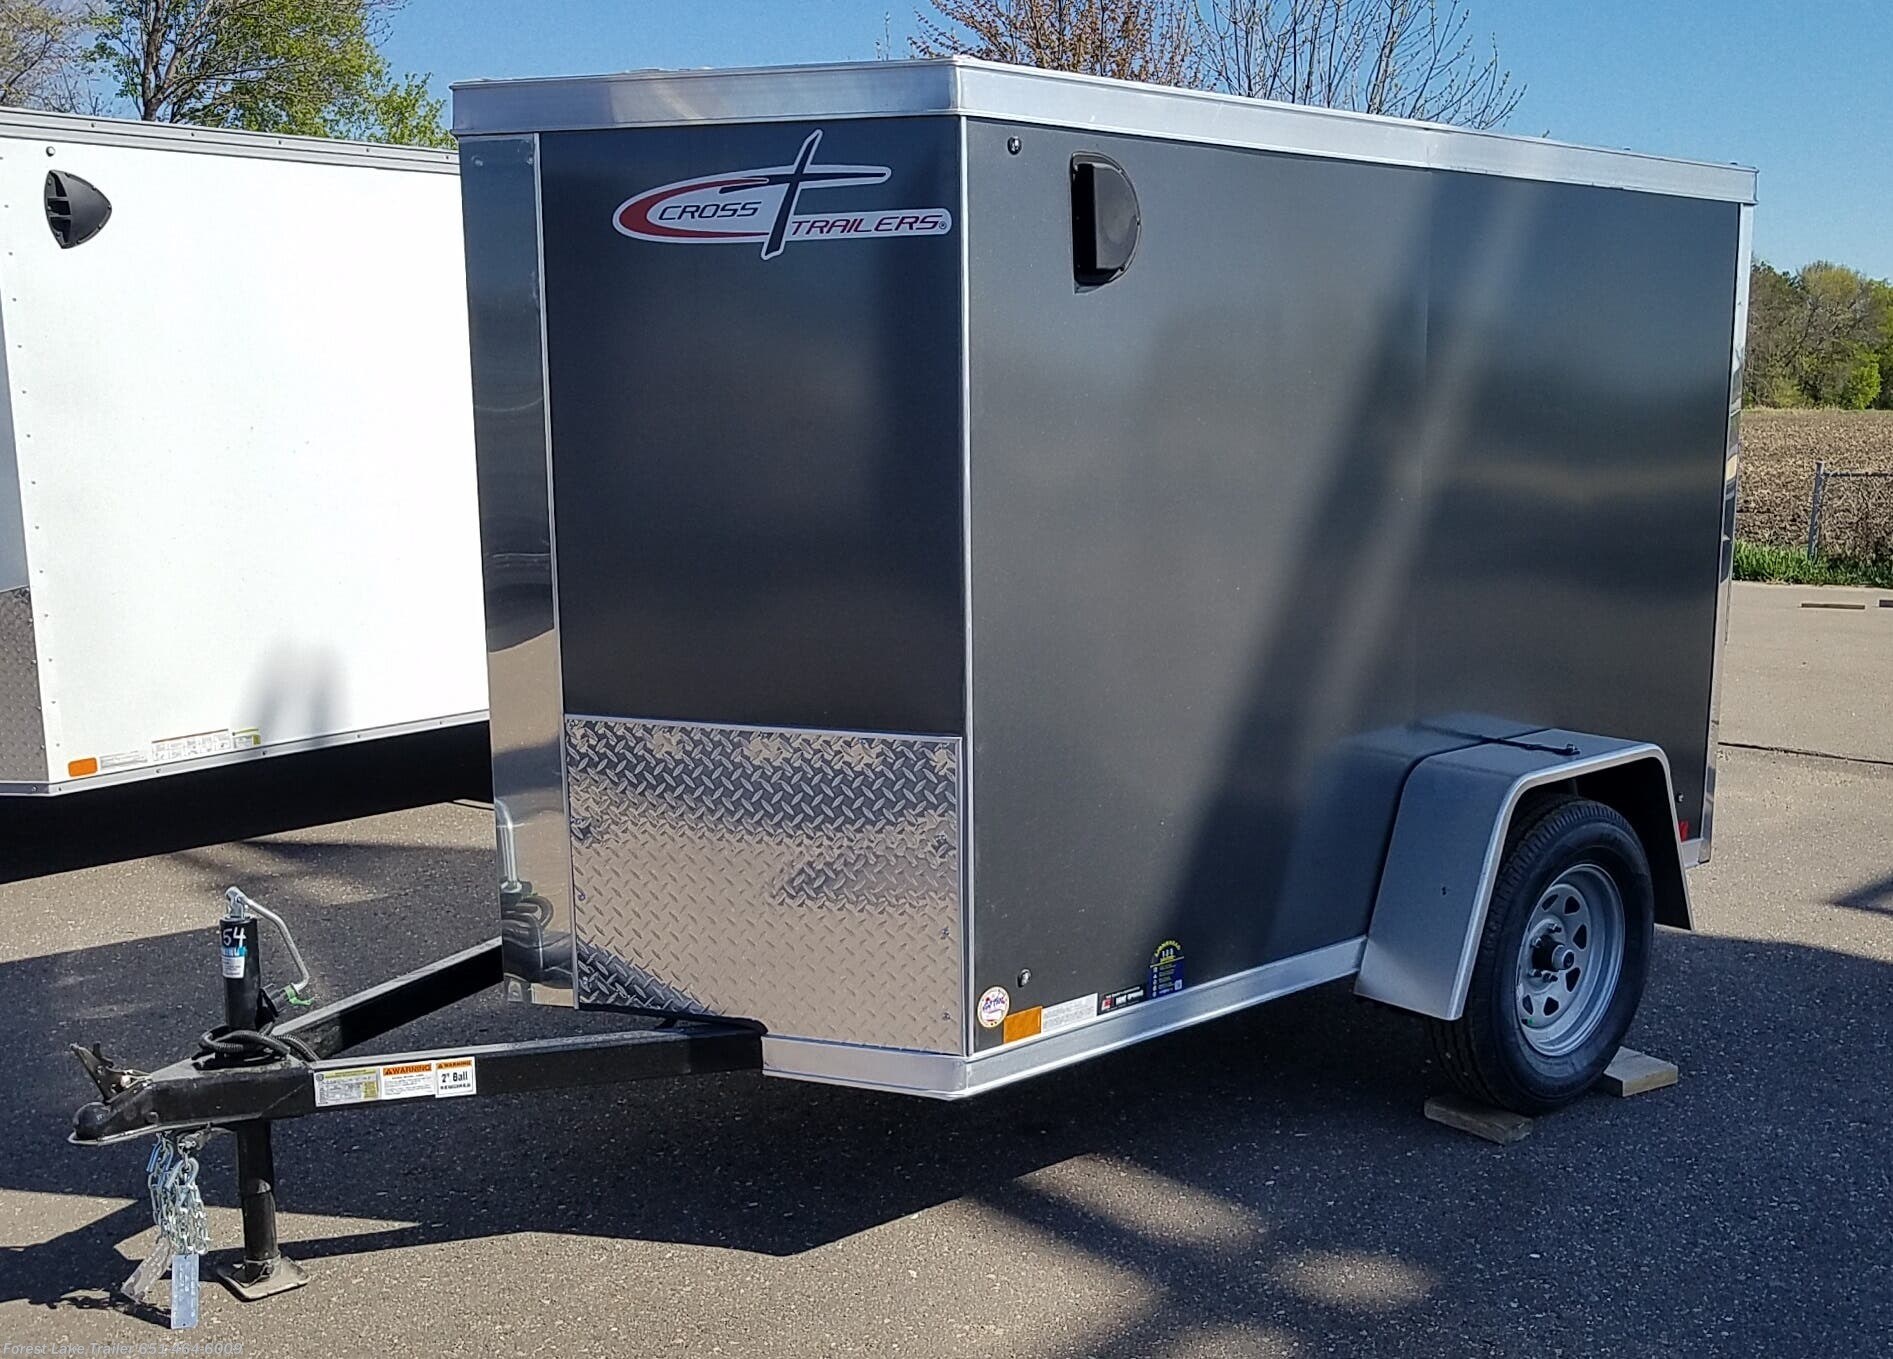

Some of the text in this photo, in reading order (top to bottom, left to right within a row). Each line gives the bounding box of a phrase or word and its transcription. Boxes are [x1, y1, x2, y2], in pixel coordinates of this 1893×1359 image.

[658, 200, 762, 220] CROSS
[392, 1064, 432, 1074] WARNING
[452, 1071, 468, 1082] Ball
